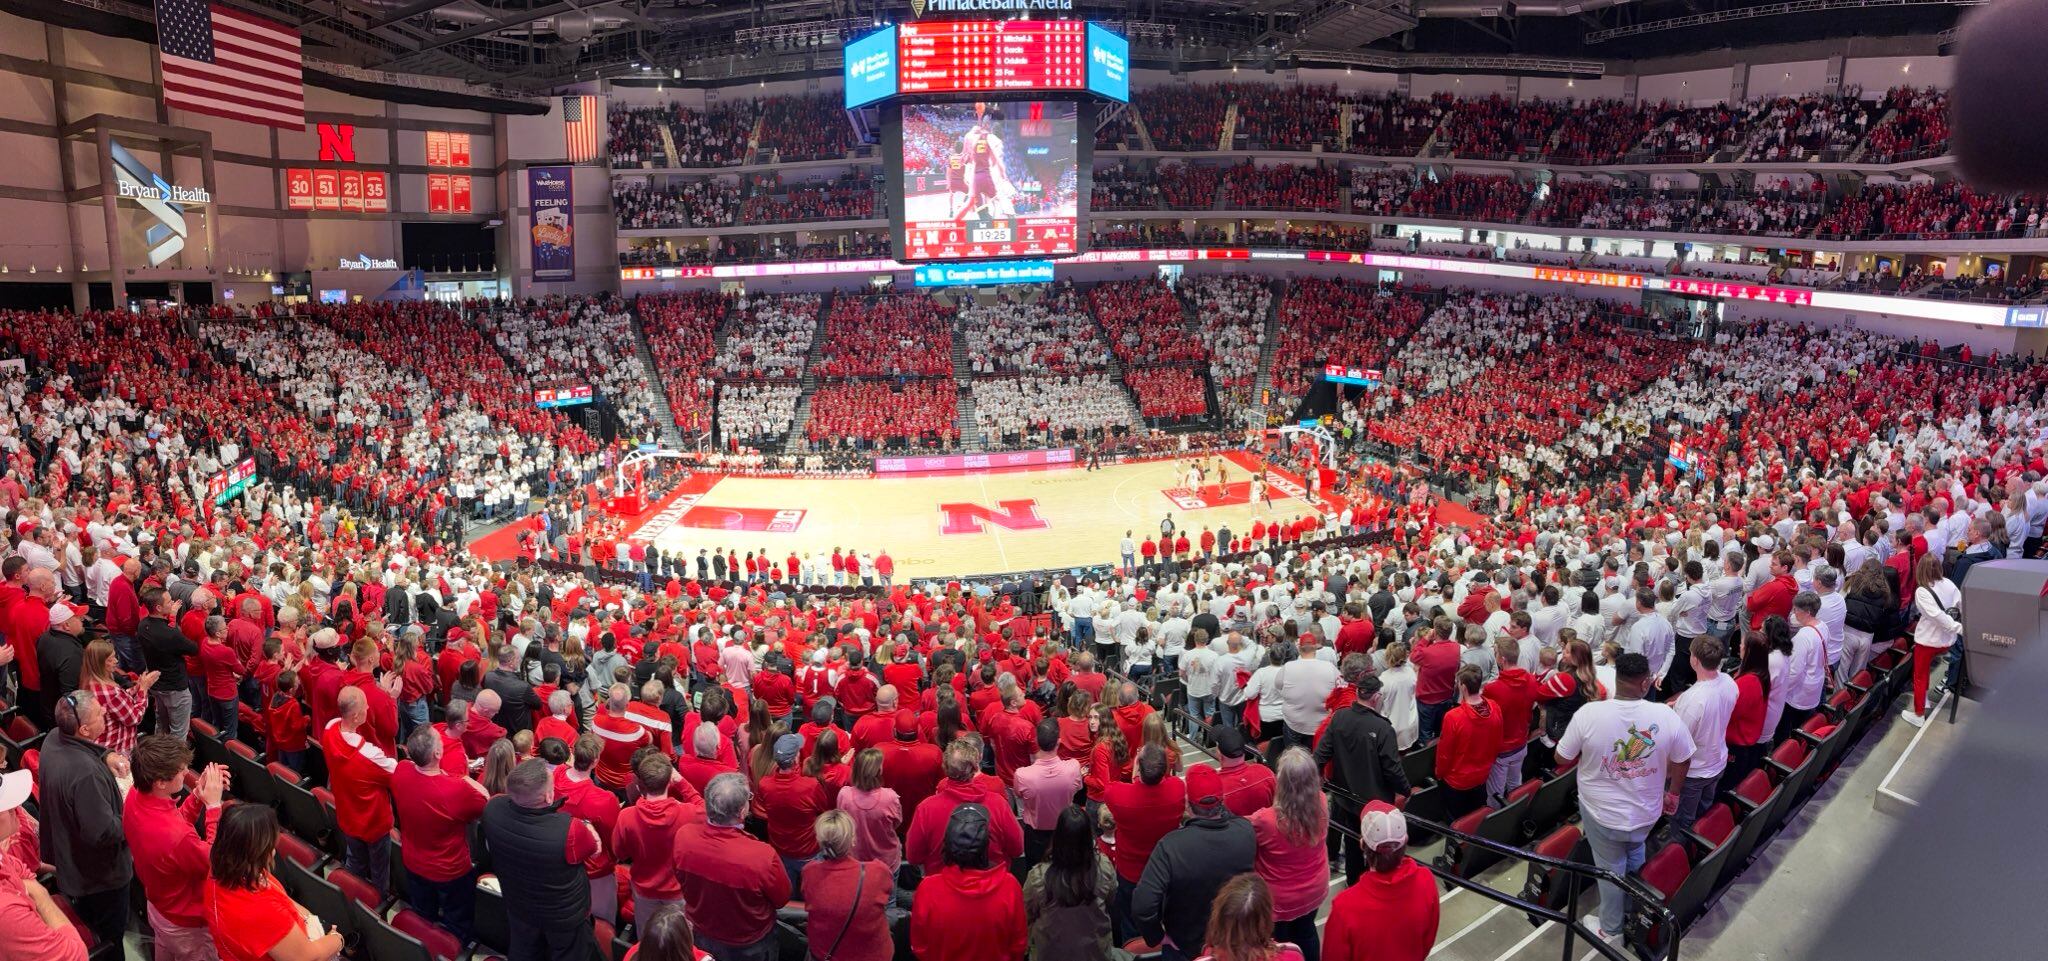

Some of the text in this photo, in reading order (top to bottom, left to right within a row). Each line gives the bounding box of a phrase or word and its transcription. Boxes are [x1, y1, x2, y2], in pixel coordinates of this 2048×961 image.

[1029, 0, 1072, 10] Arena
[317, 123, 355, 162] N
[119, 180, 211, 202] Bryan Health
[292, 180, 308, 194] 30
[320, 181, 334, 195] 51
[344, 182, 358, 196] 23
[367, 184, 383, 196] 35
[535, 199, 568, 207] FEELING
[949, 231, 957, 242] 0
[980, 230, 1006, 241] 19:25
[1026, 229, 1034, 239] 2
[1101, 250, 1141, 262] DANGEROUS
[340, 258, 397, 270] Bryan Health
[937, 496, 1052, 536] N
